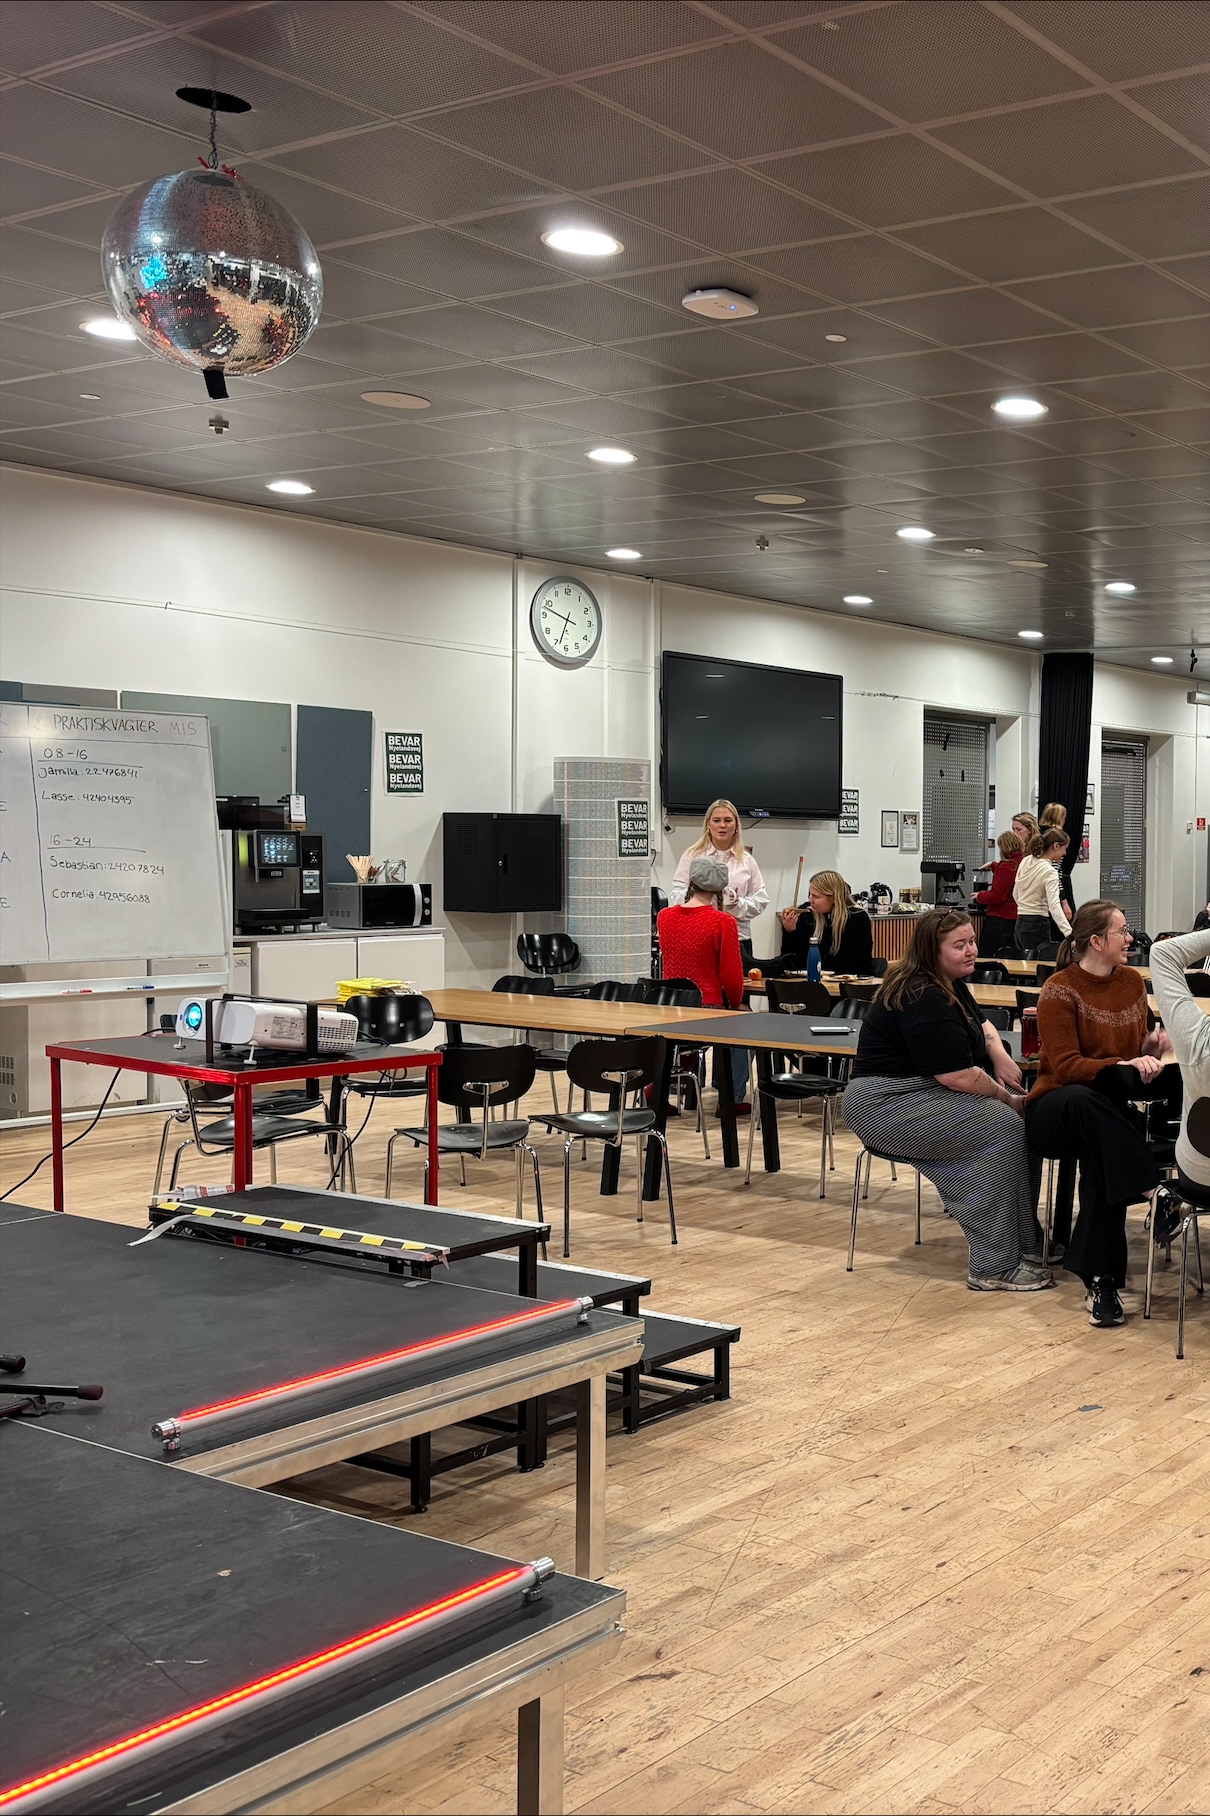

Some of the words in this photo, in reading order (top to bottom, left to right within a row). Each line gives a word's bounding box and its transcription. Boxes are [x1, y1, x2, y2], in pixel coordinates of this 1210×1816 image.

[388, 735, 421, 746] BEVAR
[389, 754, 421, 764] BEVAR
[390, 773, 422, 783] BEVAR
[621, 803, 647, 813] BEVAR
[621, 821, 647, 830] BEVAR
[622, 838, 647, 848] BEVAR
